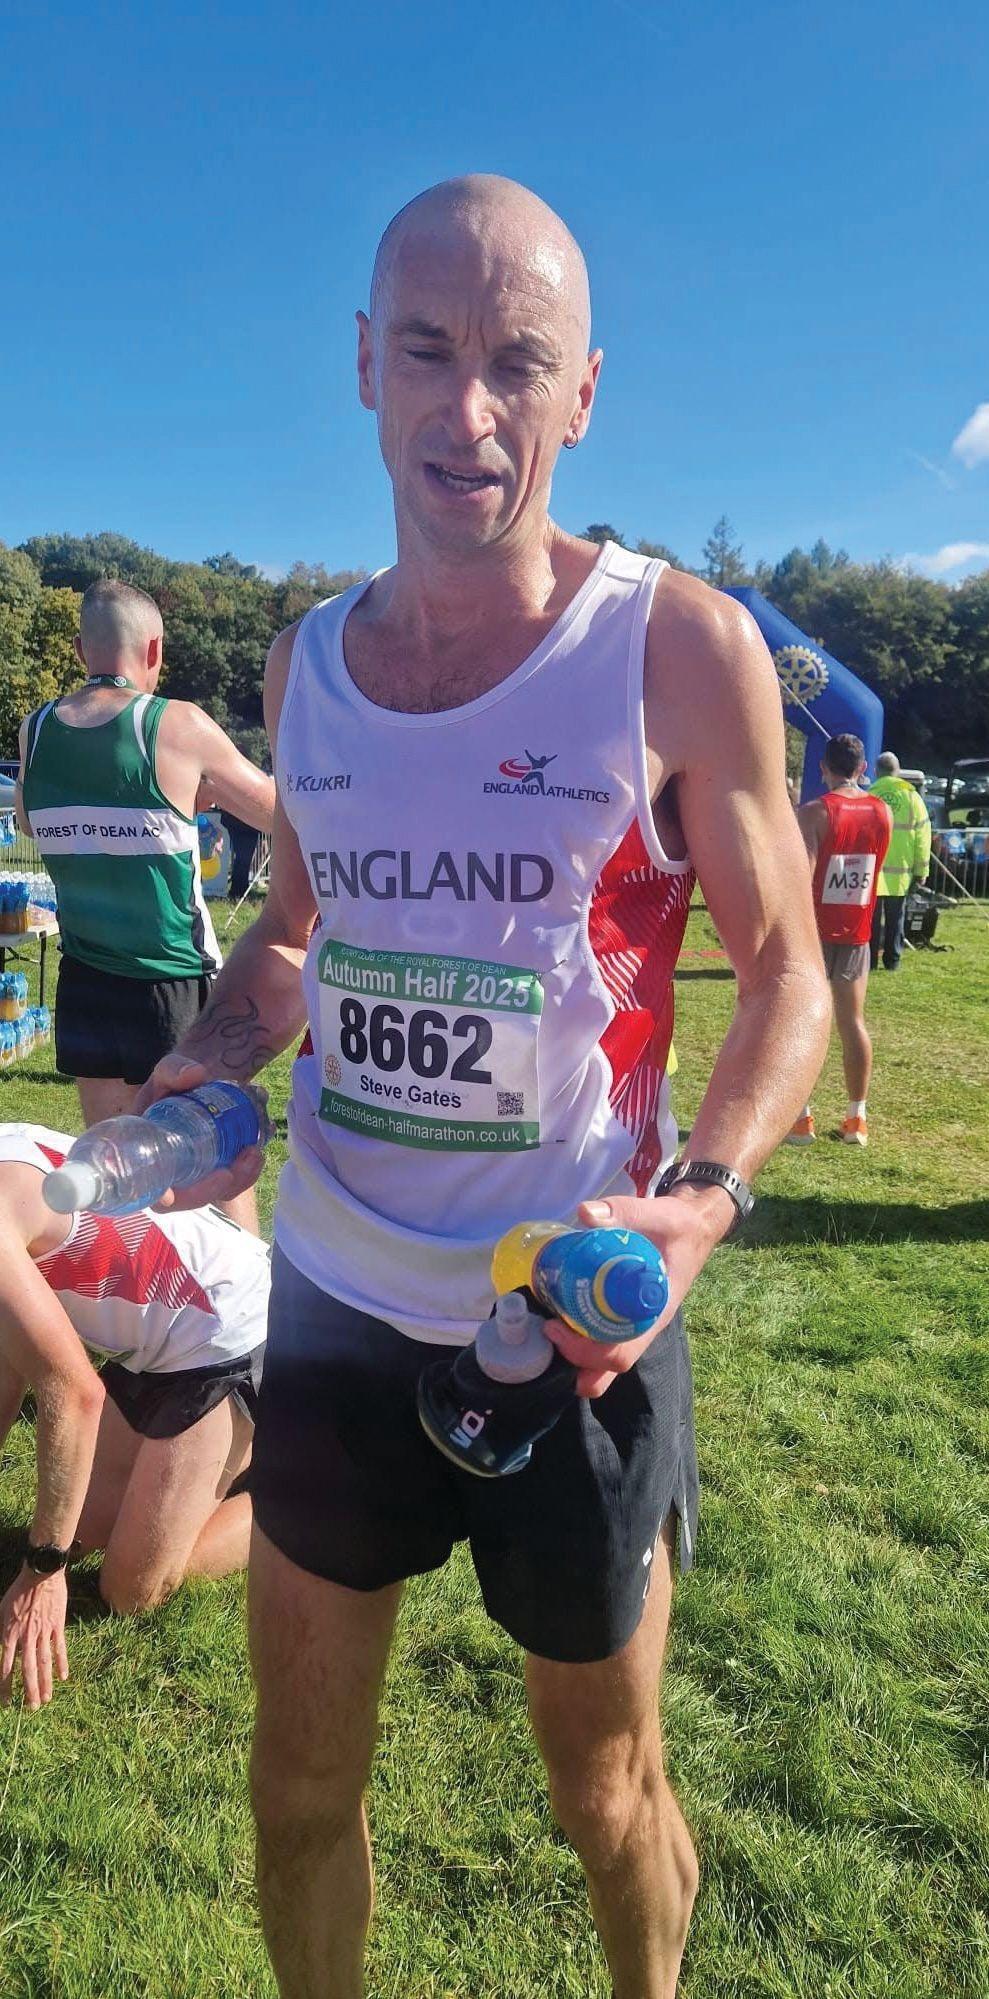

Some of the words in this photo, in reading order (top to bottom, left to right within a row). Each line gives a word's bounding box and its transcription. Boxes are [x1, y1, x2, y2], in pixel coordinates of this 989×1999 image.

[296, 775, 352, 791] KUKRI
[483, 783, 540, 795] ENGLAND
[546, 786, 610, 803] ATHLETICS
[37, 825, 78, 838] FOREST
[82, 824, 97, 835] OF
[100, 826, 137, 837] DEAN
[141, 827, 160, 837] AC
[310, 850, 554, 902] ENGLAND
[828, 872, 871, 889] M35
[391, 955, 406, 965] THE
[407, 957, 430, 967] ROYAL
[432, 958, 466, 970] FOREST
[467, 962, 480, 972] OF
[481, 964, 506, 975] DEAN
[323, 954, 396, 993] Autumn
[404, 967, 458, 999] Half
[463, 974, 531, 1008] 2025
[339, 997, 493, 1084] 8662
[360, 1074, 402, 1099] Steve
[408, 1085, 462, 1108] Gates
[330, 1097, 520, 1143] forestofdean-halfmarathon.co.uk
